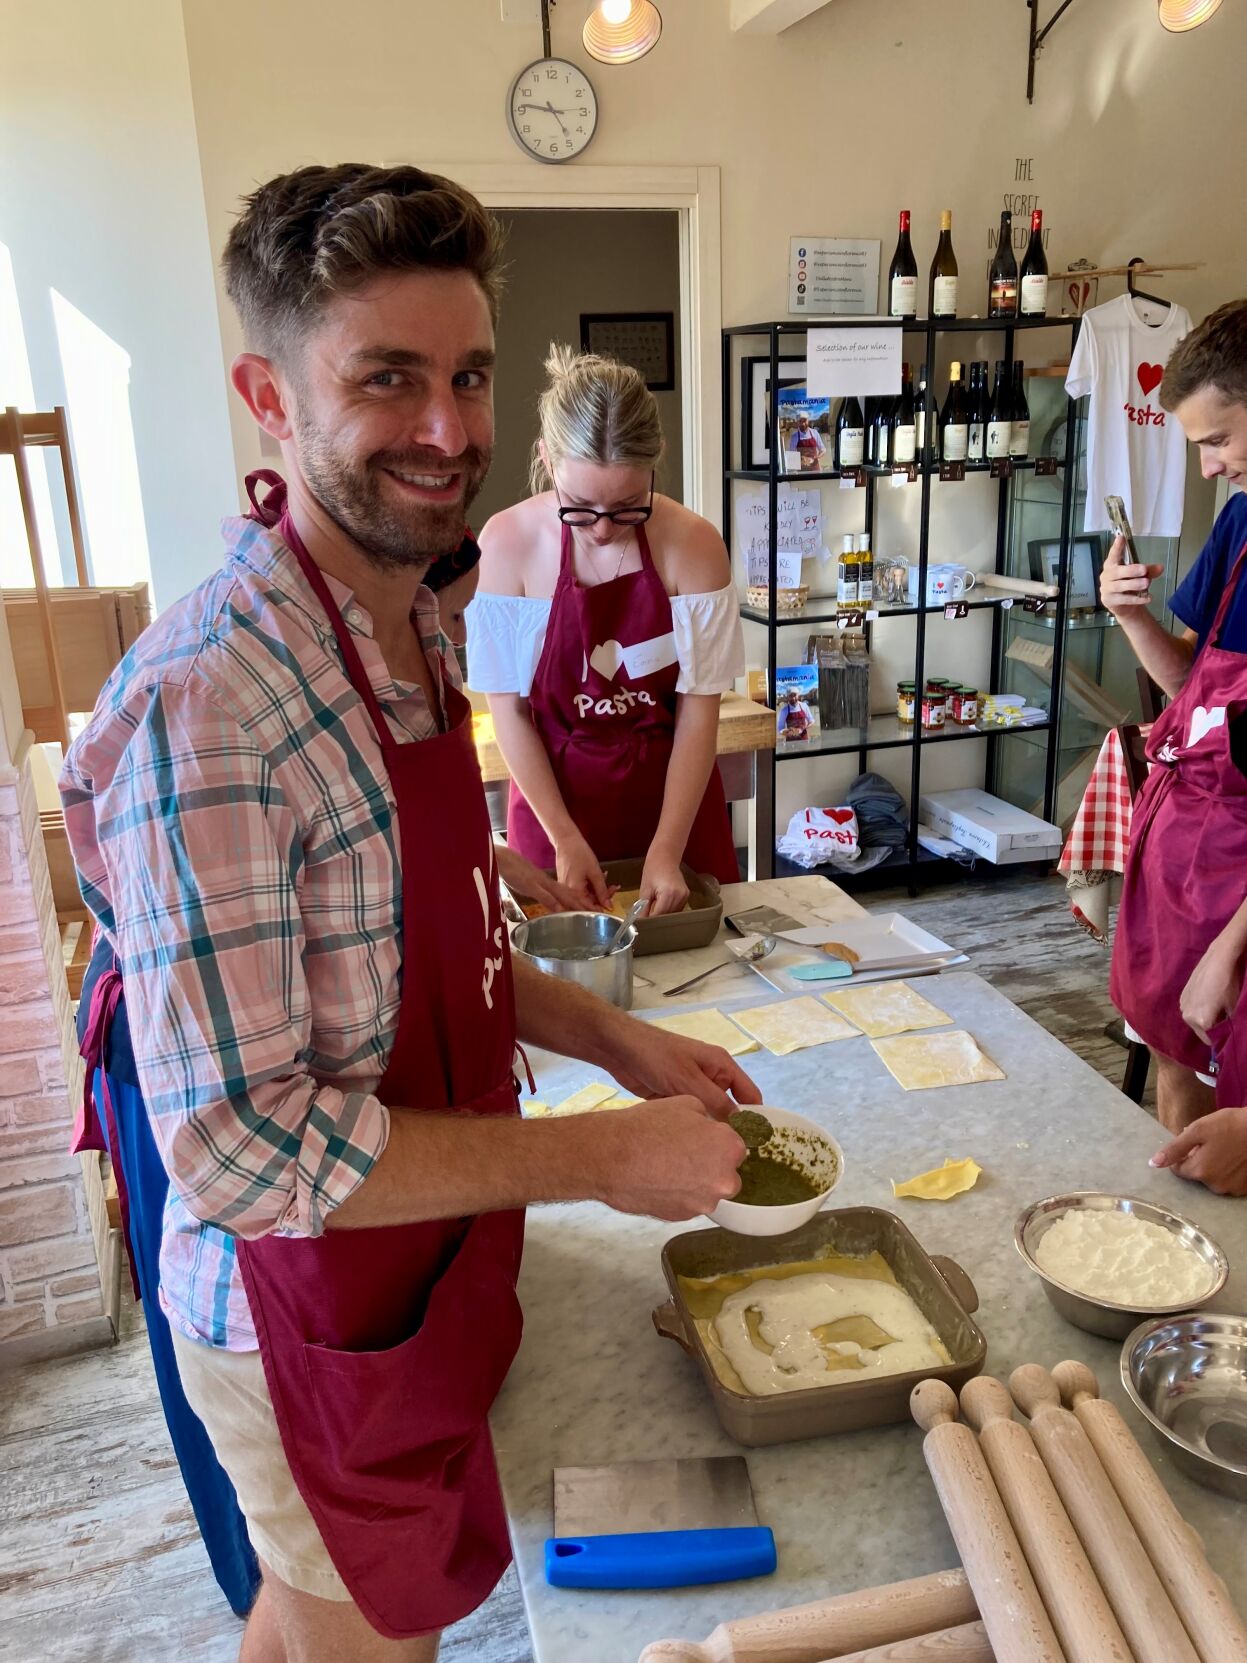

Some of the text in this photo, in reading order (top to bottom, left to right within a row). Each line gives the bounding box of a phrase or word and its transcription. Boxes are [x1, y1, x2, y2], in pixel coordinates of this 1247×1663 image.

[533, 74, 540, 83] 11
[545, 70, 558, 80] 12
[521, 89, 532, 97] 10
[575, 90, 583, 98] 2
[518, 106, 527, 116] 9
[579, 108, 588, 117] 3
[523, 125, 531, 133] 8
[534, 139, 541, 148] 7
[550, 143, 558, 152] 6
[566, 140, 573, 148] 5
[1014, 158, 1035, 181] THE
[1003, 193, 1041, 217] SECRET
[849, 342, 857, 353] of
[870, 342, 887, 351] wine
[582, 649, 588, 683] I
[573, 686, 657, 719] Pasta
[805, 808, 810, 823] I
